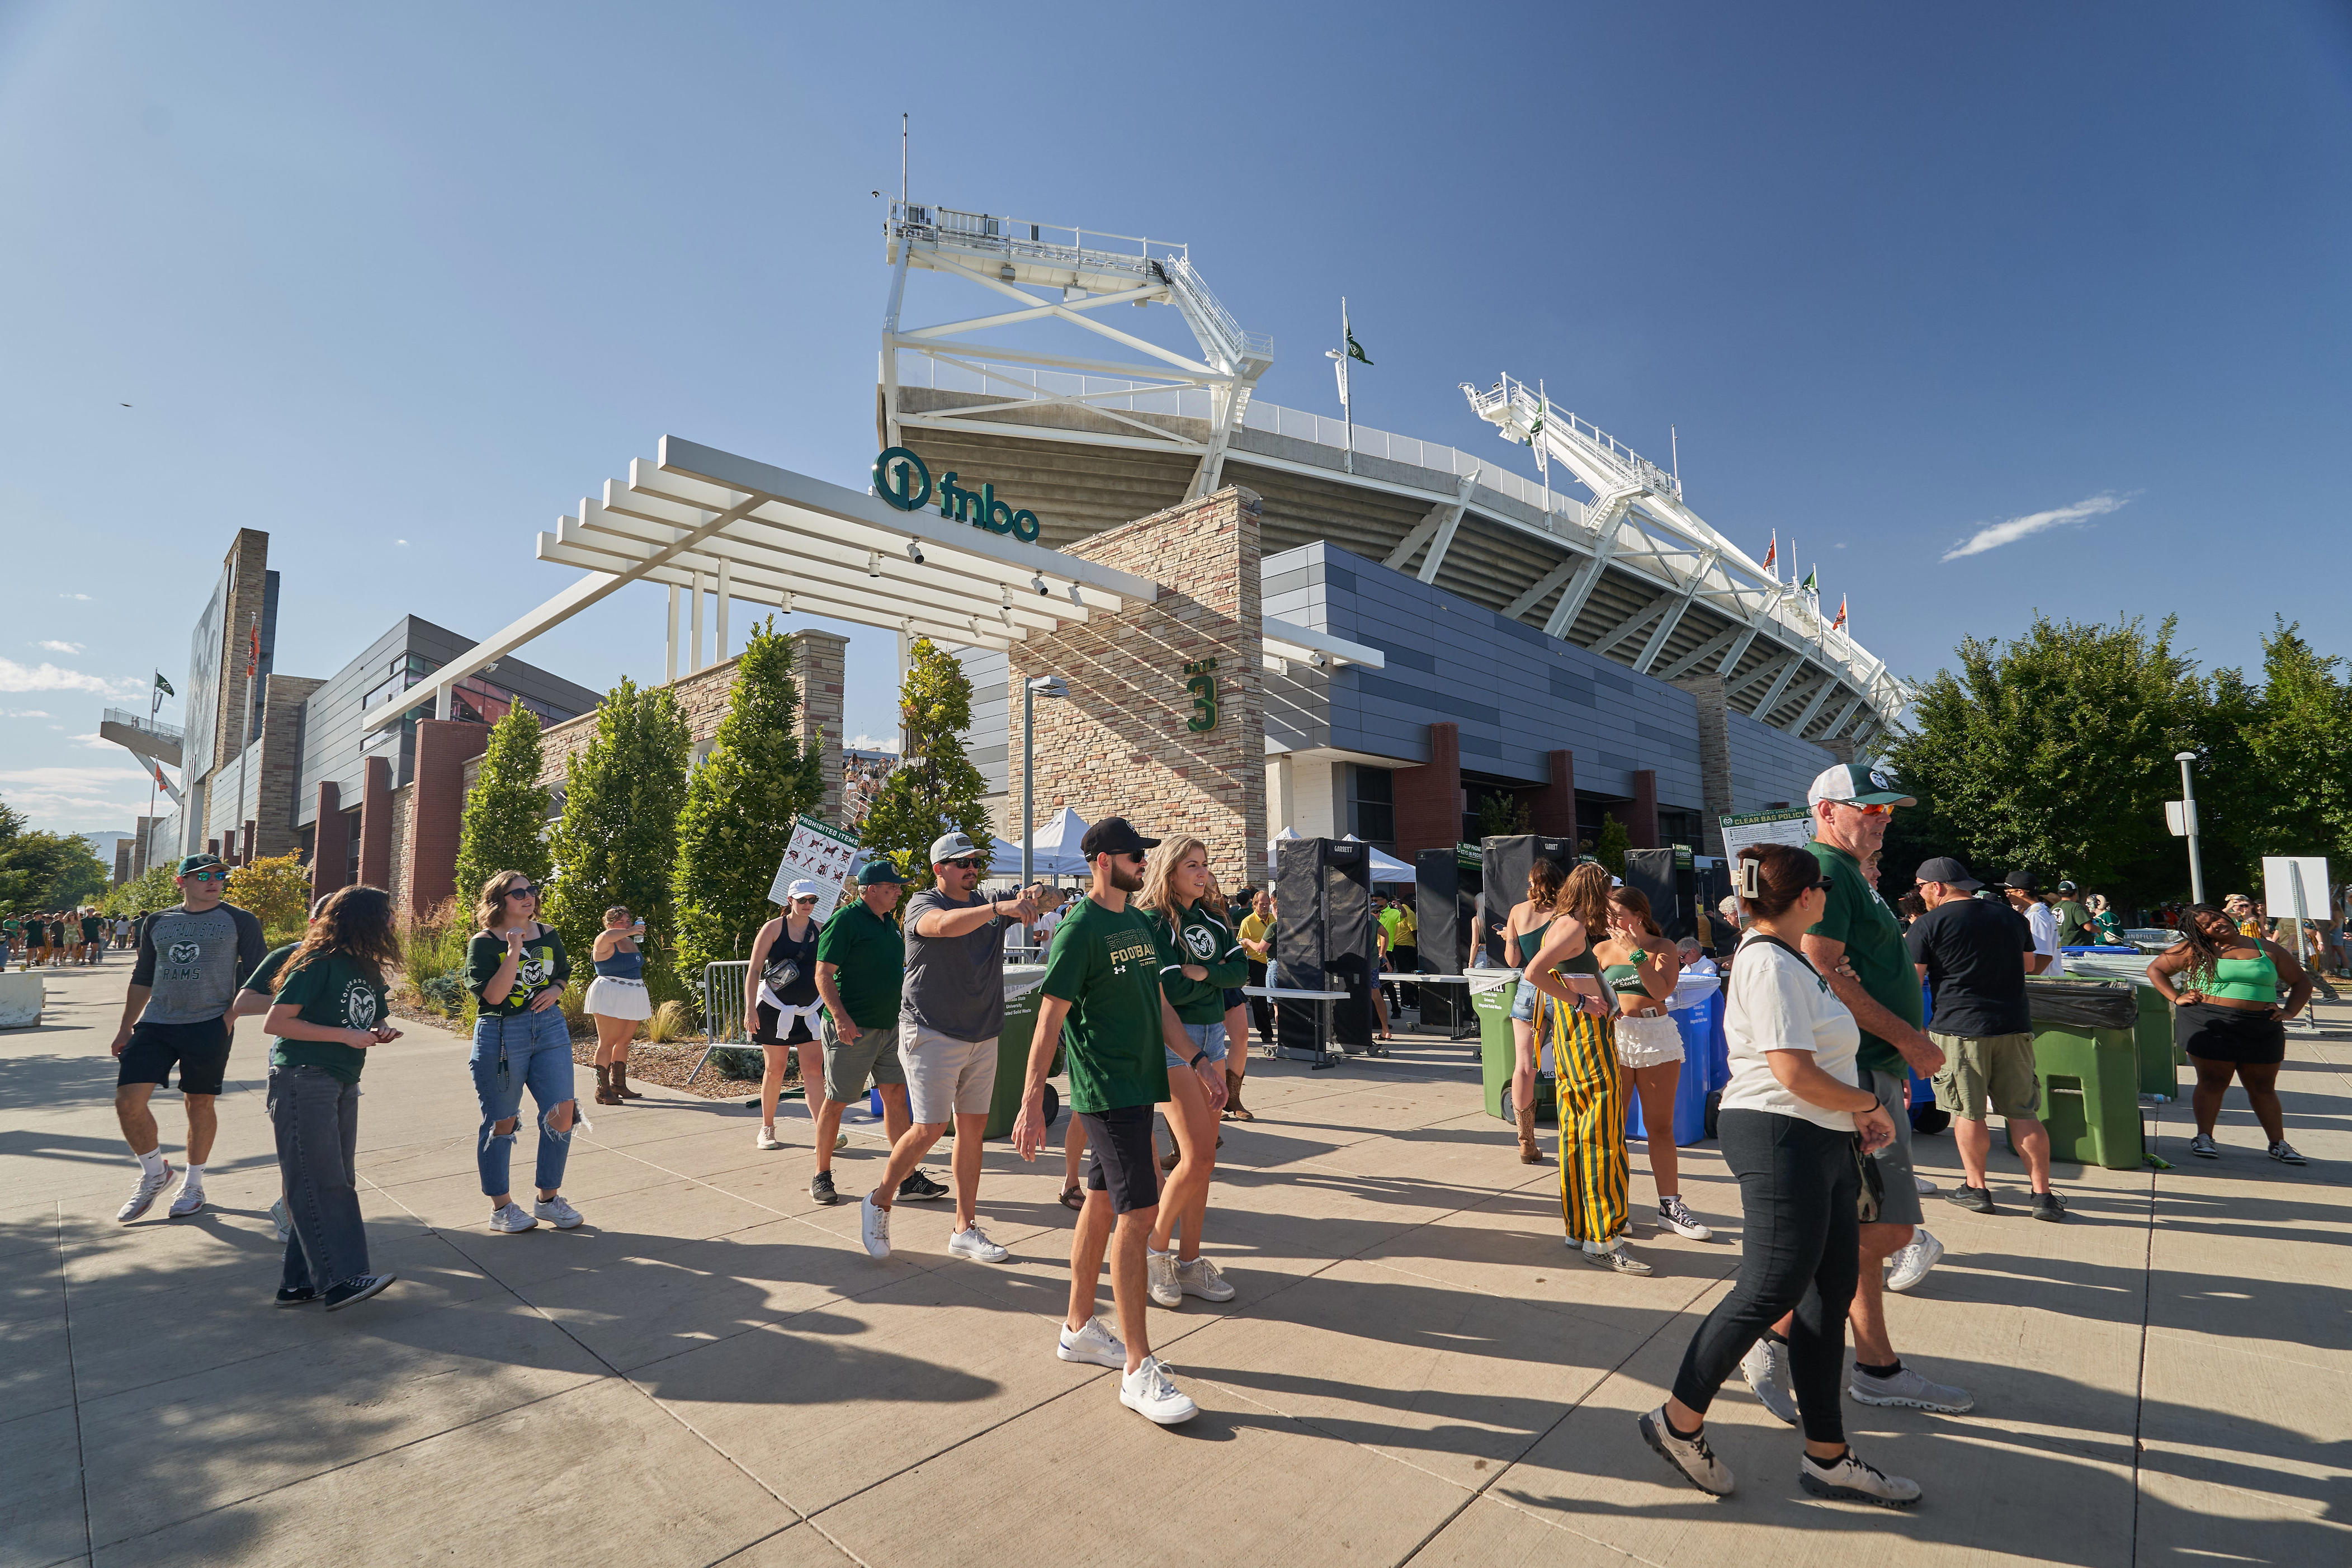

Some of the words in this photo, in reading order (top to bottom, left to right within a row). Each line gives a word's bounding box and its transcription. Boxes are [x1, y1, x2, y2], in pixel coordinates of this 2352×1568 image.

[936, 471, 1040, 544] fnbo
[1187, 675, 1218, 733] 3
[1734, 816, 1759, 825] CLEAR
[1778, 811, 1805, 820] POLICY
[799, 815, 838, 837] PROHIBITED
[838, 832, 859, 846] ITEMS
[199, 923, 226, 940] STATE
[163, 967, 202, 981] RAMS
[1608, 974, 1639, 986] Colorado
[340, 978, 367, 1003] COLORADO
